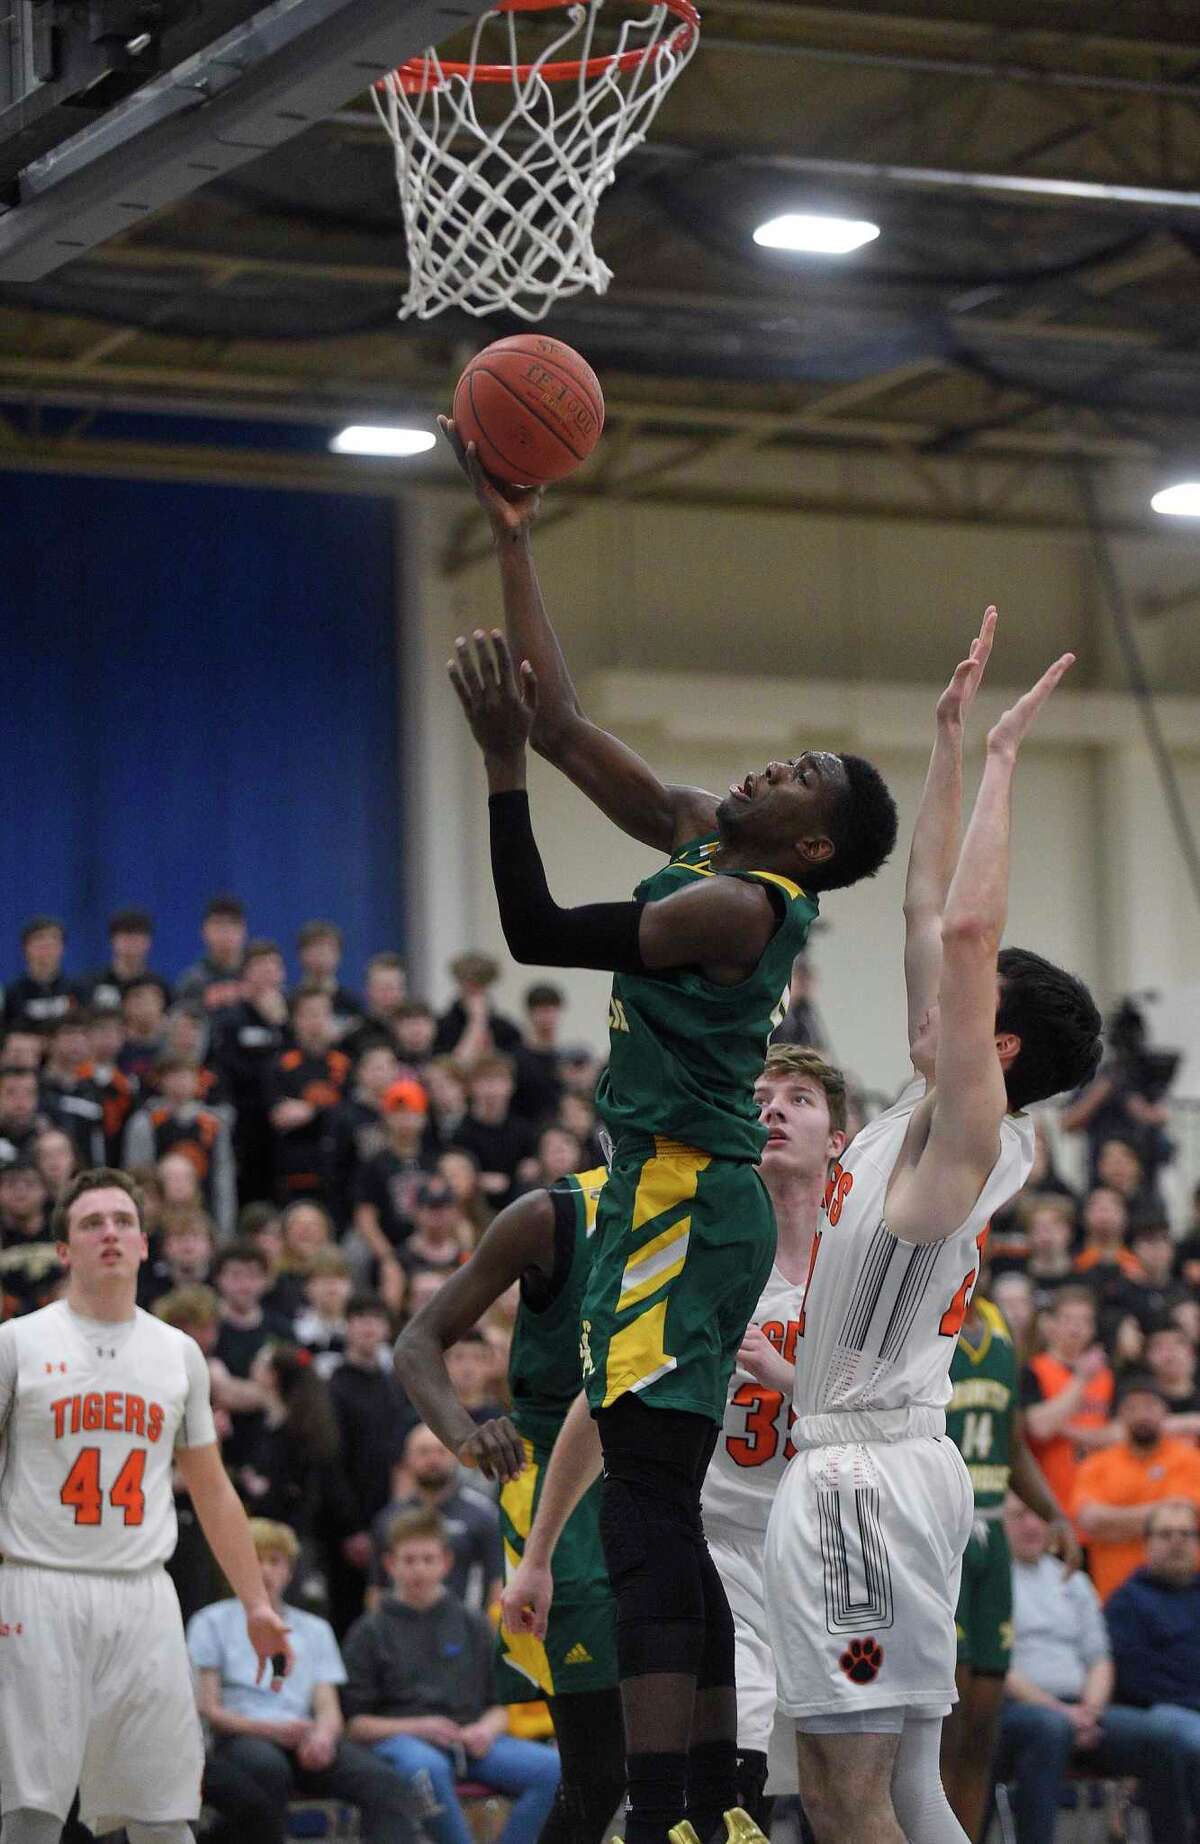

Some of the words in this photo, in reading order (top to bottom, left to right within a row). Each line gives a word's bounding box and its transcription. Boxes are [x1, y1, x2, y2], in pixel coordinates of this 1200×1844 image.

[51, 1391, 165, 1443] TIGERS
[961, 1411, 993, 1459] 14
[60, 1446, 147, 1526] 44
